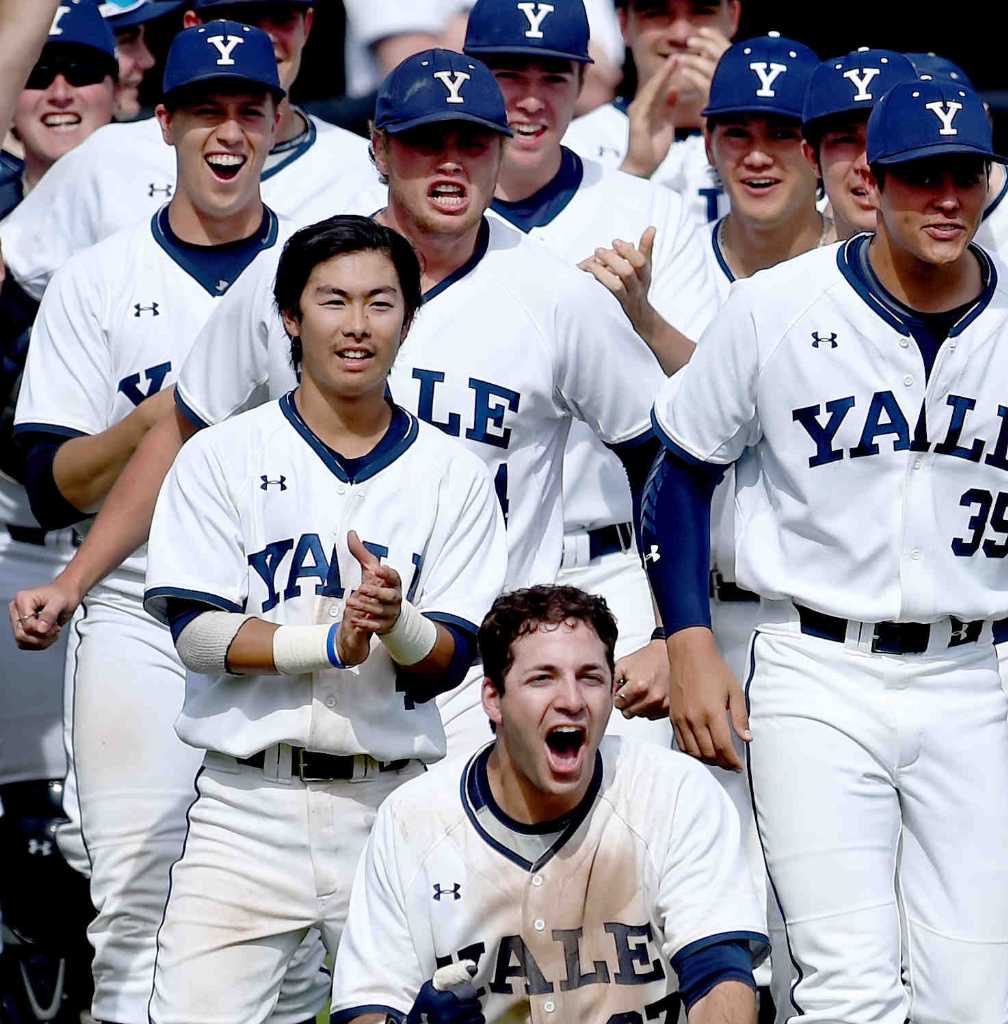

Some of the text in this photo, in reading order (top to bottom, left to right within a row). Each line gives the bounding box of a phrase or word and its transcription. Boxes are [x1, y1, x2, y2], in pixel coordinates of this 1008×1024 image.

[517, 2, 554, 38] Y
[207, 35, 244, 65] Y
[433, 71, 470, 103] Y
[750, 62, 787, 97] Y
[843, 68, 880, 101] Y
[925, 102, 962, 135] Y
[412, 367, 521, 450] LE
[247, 533, 422, 614] YA
